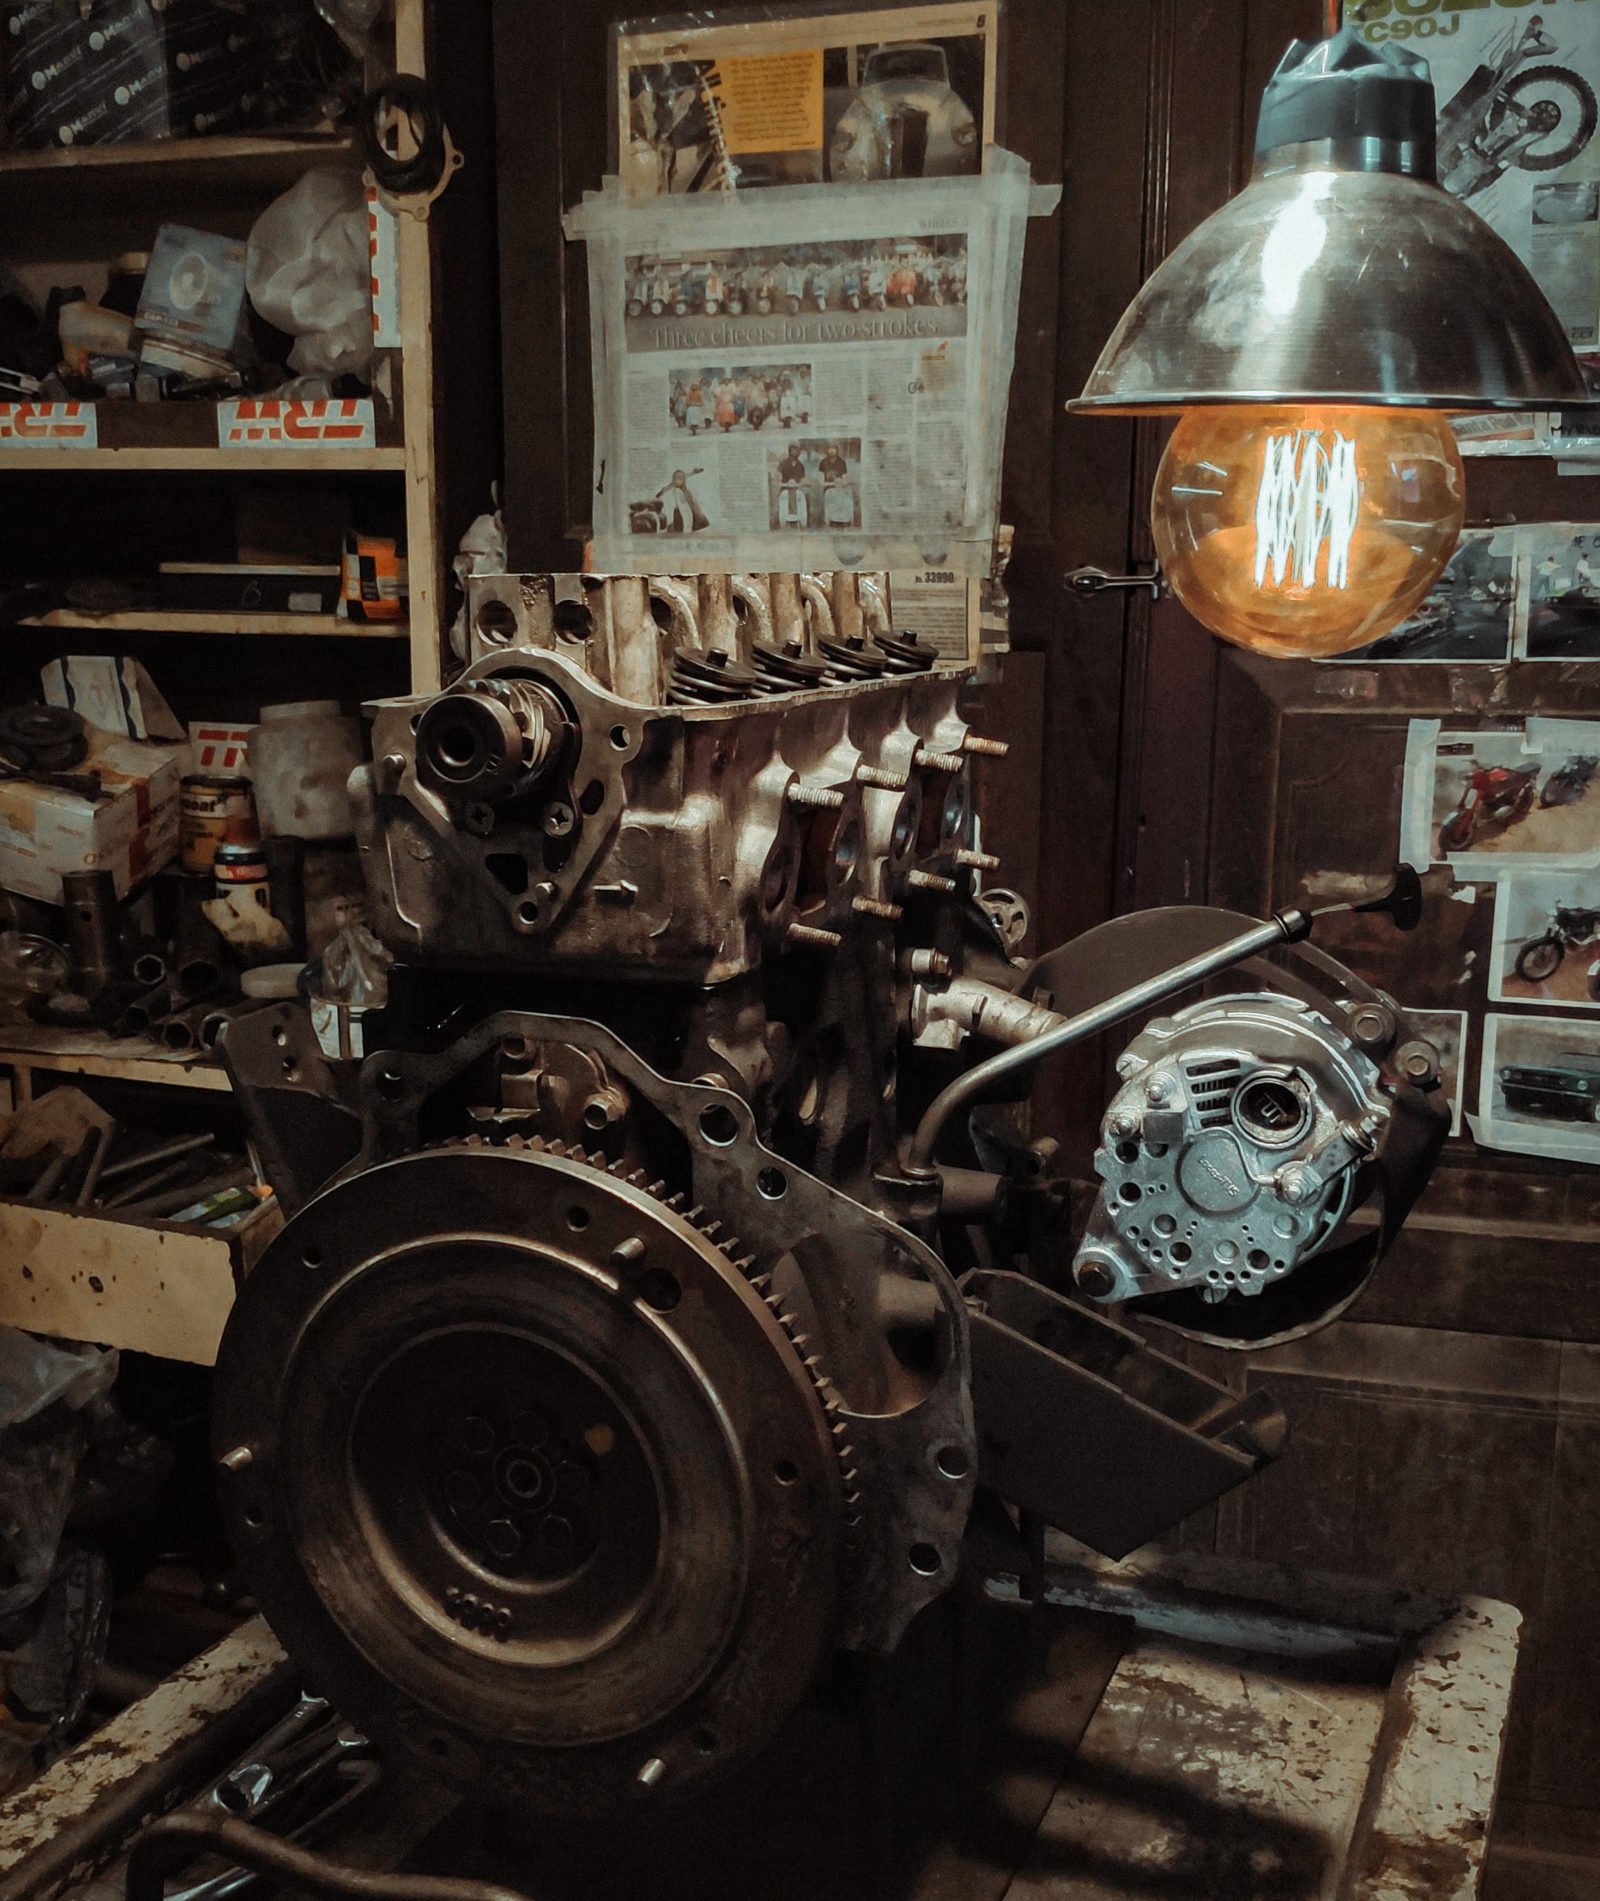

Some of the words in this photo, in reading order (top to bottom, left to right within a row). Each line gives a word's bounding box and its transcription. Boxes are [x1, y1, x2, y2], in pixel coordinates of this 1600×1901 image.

[1360, 14, 1459, 43] C90J
[652, 325, 703, 349] Three
[711, 322, 776, 347] cheers
[783, 319, 812, 343] for
[817, 313, 939, 341] two-strokes
[0, 402, 87, 438] TR
[228, 399, 366, 442] TRW
[925, 572, 954, 584] 33990
[198, 729, 250, 767] TR
